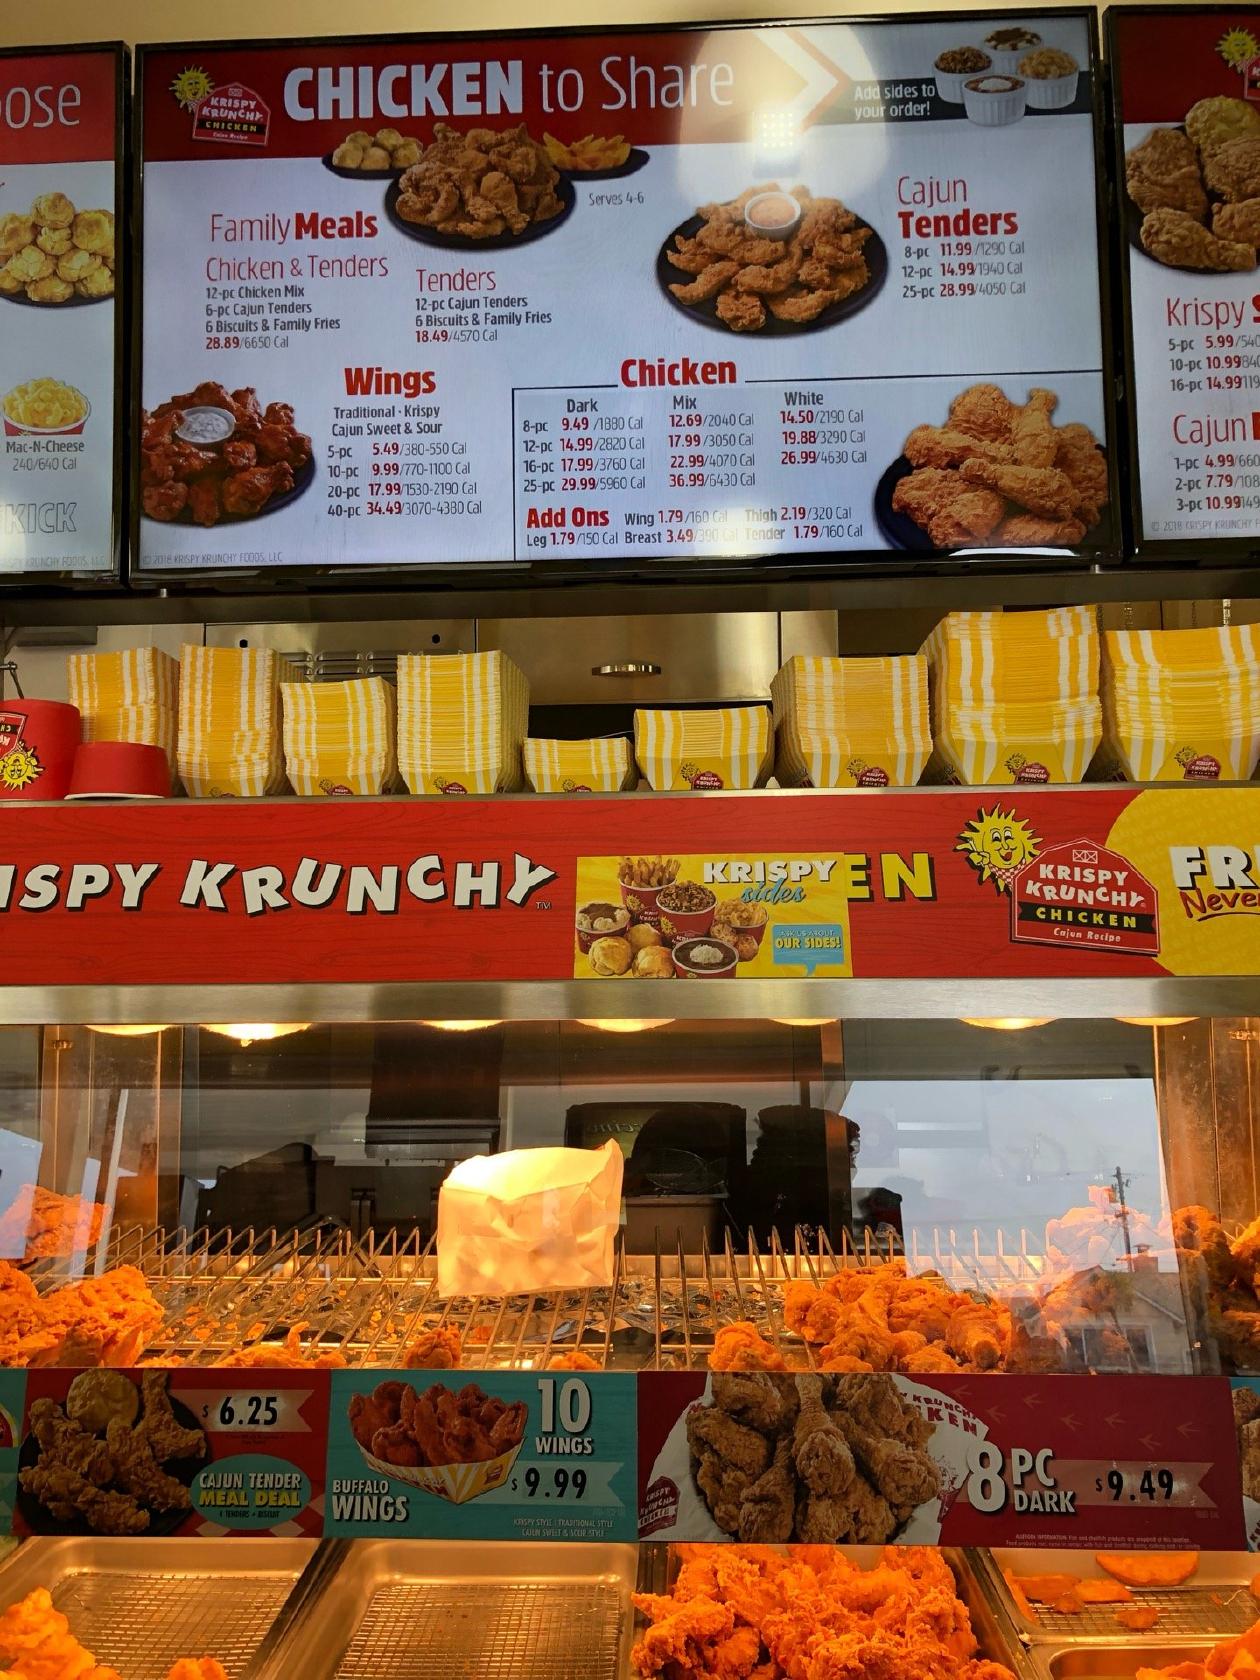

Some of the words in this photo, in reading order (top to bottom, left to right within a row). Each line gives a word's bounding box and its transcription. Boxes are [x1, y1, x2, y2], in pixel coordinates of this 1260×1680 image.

[283, 60, 524, 122] CHICKEN
[538, 62, 585, 114] to
[600, 54, 735, 114] Share
[854, 84, 880, 101] Add
[884, 83, 918, 99] sides
[921, 83, 936, 98] to
[210, 96, 257, 110] KRISPY
[855, 105, 887, 121] your
[890, 100, 931, 117] order!
[201, 106, 264, 121] KRUNCHY
[205, 120, 257, 133] CHICKEN
[589, 192, 623, 206] Serves
[626, 191, 645, 205] 4-6
[898, 175, 968, 208] Cajun
[211, 213, 291, 245] Family
[294, 210, 378, 241] Meals
[897, 207, 1019, 239] Tenders
[904, 246, 930, 260] 8-pc
[1009, 240, 1025, 255] Cal
[206, 256, 284, 282] Chicken
[290, 257, 303, 278] &
[307, 254, 389, 279] Tenders
[901, 265, 933, 280] 12-pc
[1007, 261, 1023, 275] Cal
[415, 267, 496, 293] Tenders
[206, 287, 234, 301] 12-pc
[238, 286, 282, 299] Chicken
[284, 285, 305, 298] Mix
[902, 285, 935, 299] 25-pc
[1010, 281, 1026, 295] Cal
[205, 303, 230, 318] 6-pc
[233, 303, 265, 317] Cajun
[268, 302, 312, 315] Tenders
[415, 298, 445, 312] 12-pc
[447, 297, 480, 312] Cajun
[483, 295, 528, 309] Tenders
[415, 314, 423, 327] 6
[426, 313, 469, 327] Biscuits
[471, 312, 480, 326] &
[484, 311, 522, 327] Family
[525, 310, 552, 324] Fries
[1166, 297, 1245, 331] Krispy
[205, 321, 213, 334] 6
[216, 320, 258, 333] Biscuits
[261, 319, 270, 332] &
[273, 316, 311, 333] Family
[314, 316, 341, 330] Fries
[273, 336, 289, 348] Cal
[482, 329, 498, 343] Cal
[1168, 338, 1195, 353] 5-pc
[620, 357, 738, 388] Chicken
[1169, 358, 1203, 373] 10-pc
[344, 366, 437, 399] Wings
[1170, 379, 1203, 394] 16-pc
[334, 405, 396, 420] Traditional
[404, 404, 441, 419] Krispy
[566, 397, 599, 414] Dark
[672, 394, 698, 411] Mix
[784, 391, 824, 406] White
[332, 423, 364, 438] Cajun
[366, 422, 402, 437] Sweet
[404, 422, 413, 435] &
[416, 421, 443, 435] Sour
[522, 419, 549, 435] 8-pc
[628, 416, 644, 431] Cal
[738, 412, 754, 427] Cal
[848, 408, 864, 424] Cal
[1172, 414, 1247, 448] Cajun
[6, 440, 85, 454] Mac-N-Cheese
[327, 444, 353, 460] 5-pc
[451, 441, 467, 455] Cal
[522, 439, 554, 455] 12-pc
[628, 436, 646, 451] Cal
[738, 432, 754, 447] Cal
[850, 429, 866, 445] Cal
[12, 457, 59, 472] 240/640
[62, 456, 77, 470] Cal
[327, 464, 359, 480] 10-pc
[455, 461, 471, 475] Cal
[523, 459, 555, 475] 16-pc
[629, 456, 646, 471] Cal
[739, 452, 755, 467] Cal
[851, 449, 868, 464] Cal
[1173, 457, 1200, 473] 1-pc
[327, 485, 360, 500] 20-pc
[462, 481, 477, 496] Cal
[523, 478, 556, 495] 25-pc
[630, 476, 646, 490] Cal
[739, 472, 756, 487] Cal
[1174, 477, 1202, 493] 2-pc
[327, 504, 361, 519] 40-pc
[467, 500, 482, 515] Cal
[1175, 498, 1203, 514] 3-pc
[526, 507, 566, 530] Add
[571, 507, 610, 529] Ons
[624, 512, 655, 528] Wing
[712, 509, 728, 523] Cal
[745, 508, 778, 523] Thigh
[835, 506, 852, 521] Cal
[526, 533, 547, 549] Leg
[602, 531, 619, 545] Cal
[624, 529, 662, 545] Breast
[745, 527, 786, 541] Tender
[847, 524, 864, 538] Cal
[703, 860, 838, 885] KRISPY
[1038, 863, 1129, 887] KRISPY
[1168, 845, 1260, 890] FR
[0, 864, 161, 909] ISPY
[180, 852, 557, 914] KRUNCHY
[740, 877, 807, 906] sides
[1025, 879, 1145, 908] KRUNCHY
[1035, 906, 1137, 929] CHICKEN
[775, 936, 801, 949] OUR
[804, 936, 842, 949] SIDES!
[1053, 926, 1083, 940] Cajun
[1086, 929, 1122, 943] Recipe
[537, 1377, 592, 1434] 10
[535, 1436, 594, 1455] WINGS
[199, 1472, 244, 1489] CAJUN
[249, 1472, 302, 1489] TENDER
[966, 1439, 1008, 1512] 8
[1010, 1447, 1055, 1487] PC
[332, 1479, 389, 1494] BUFFALO
[199, 1490, 250, 1507] MEAL
[255, 1490, 302, 1507] DEAL
[332, 1495, 409, 1521] WINGS
[1013, 1489, 1076, 1513] DARK
